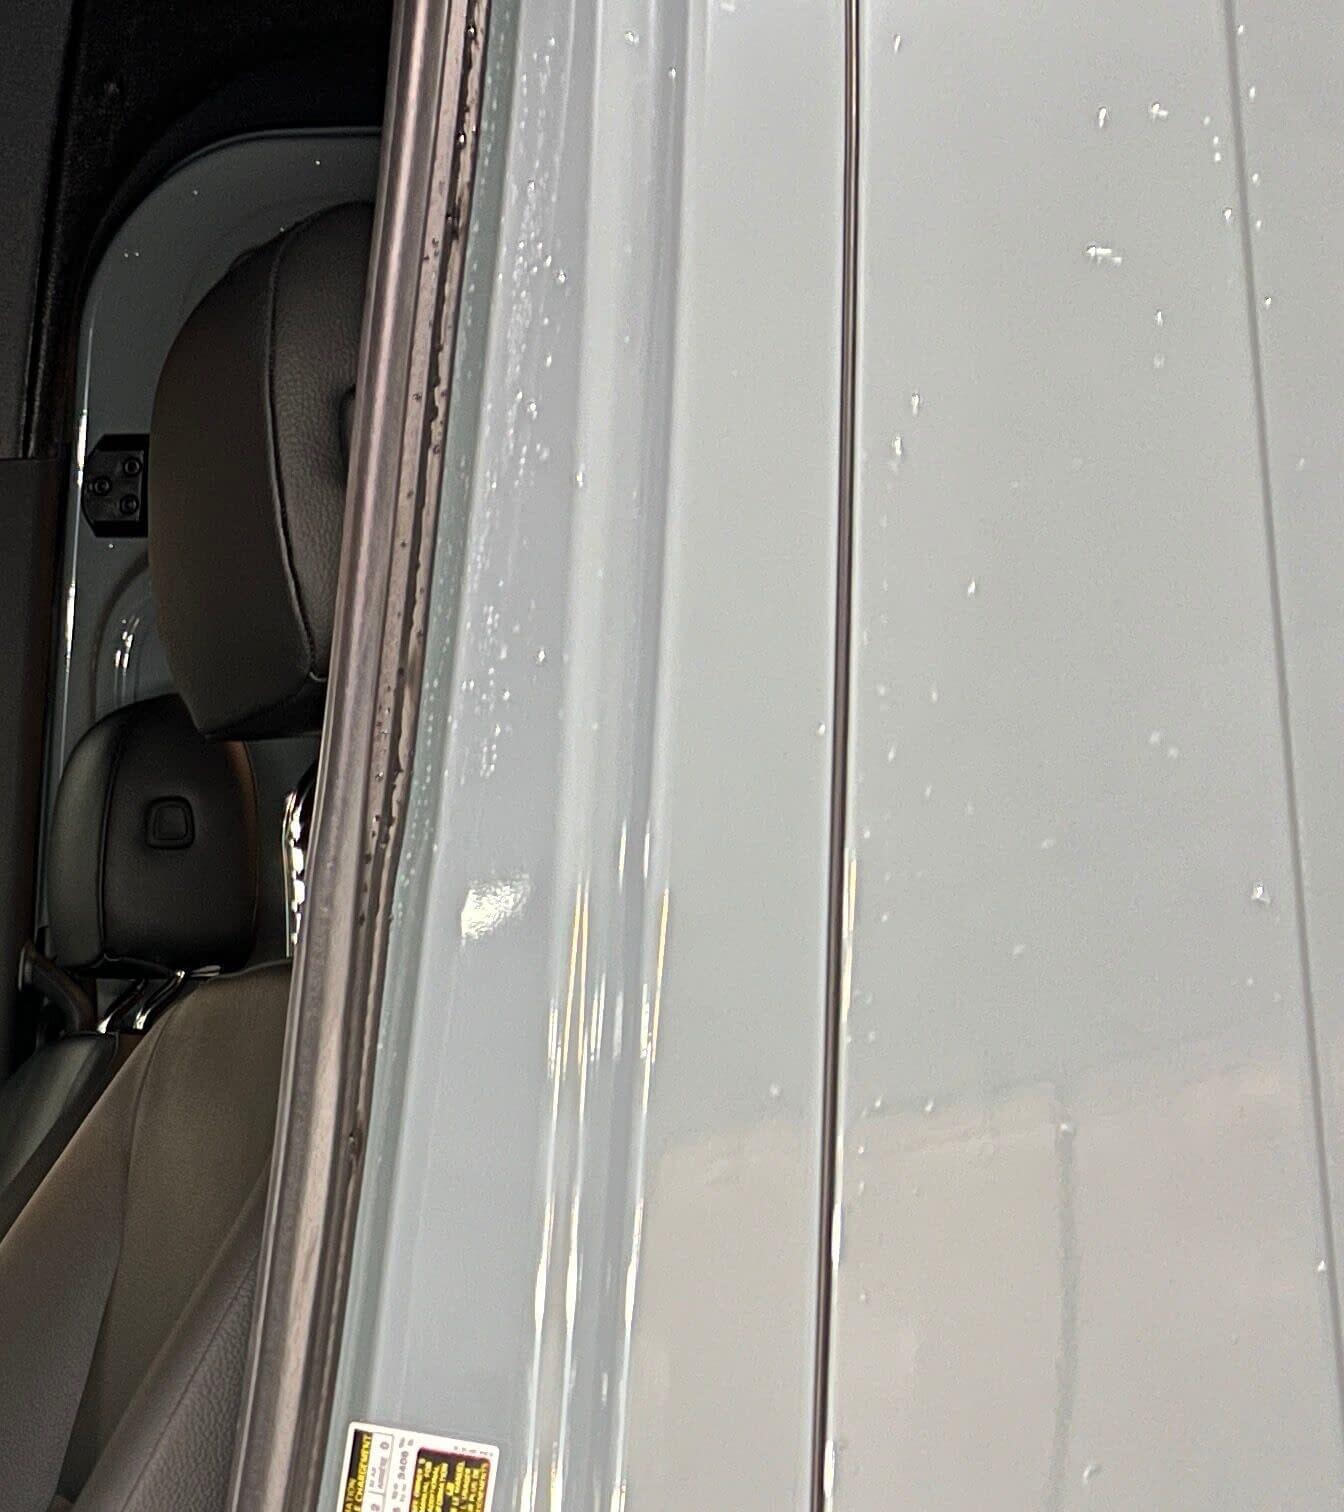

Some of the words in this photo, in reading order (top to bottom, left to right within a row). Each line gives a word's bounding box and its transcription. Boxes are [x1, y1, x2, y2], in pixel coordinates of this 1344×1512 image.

[380, 1440, 389, 1450] 0
[354, 1433, 371, 1502] CHARGEMENT
[370, 1502, 380, 1512] 2
